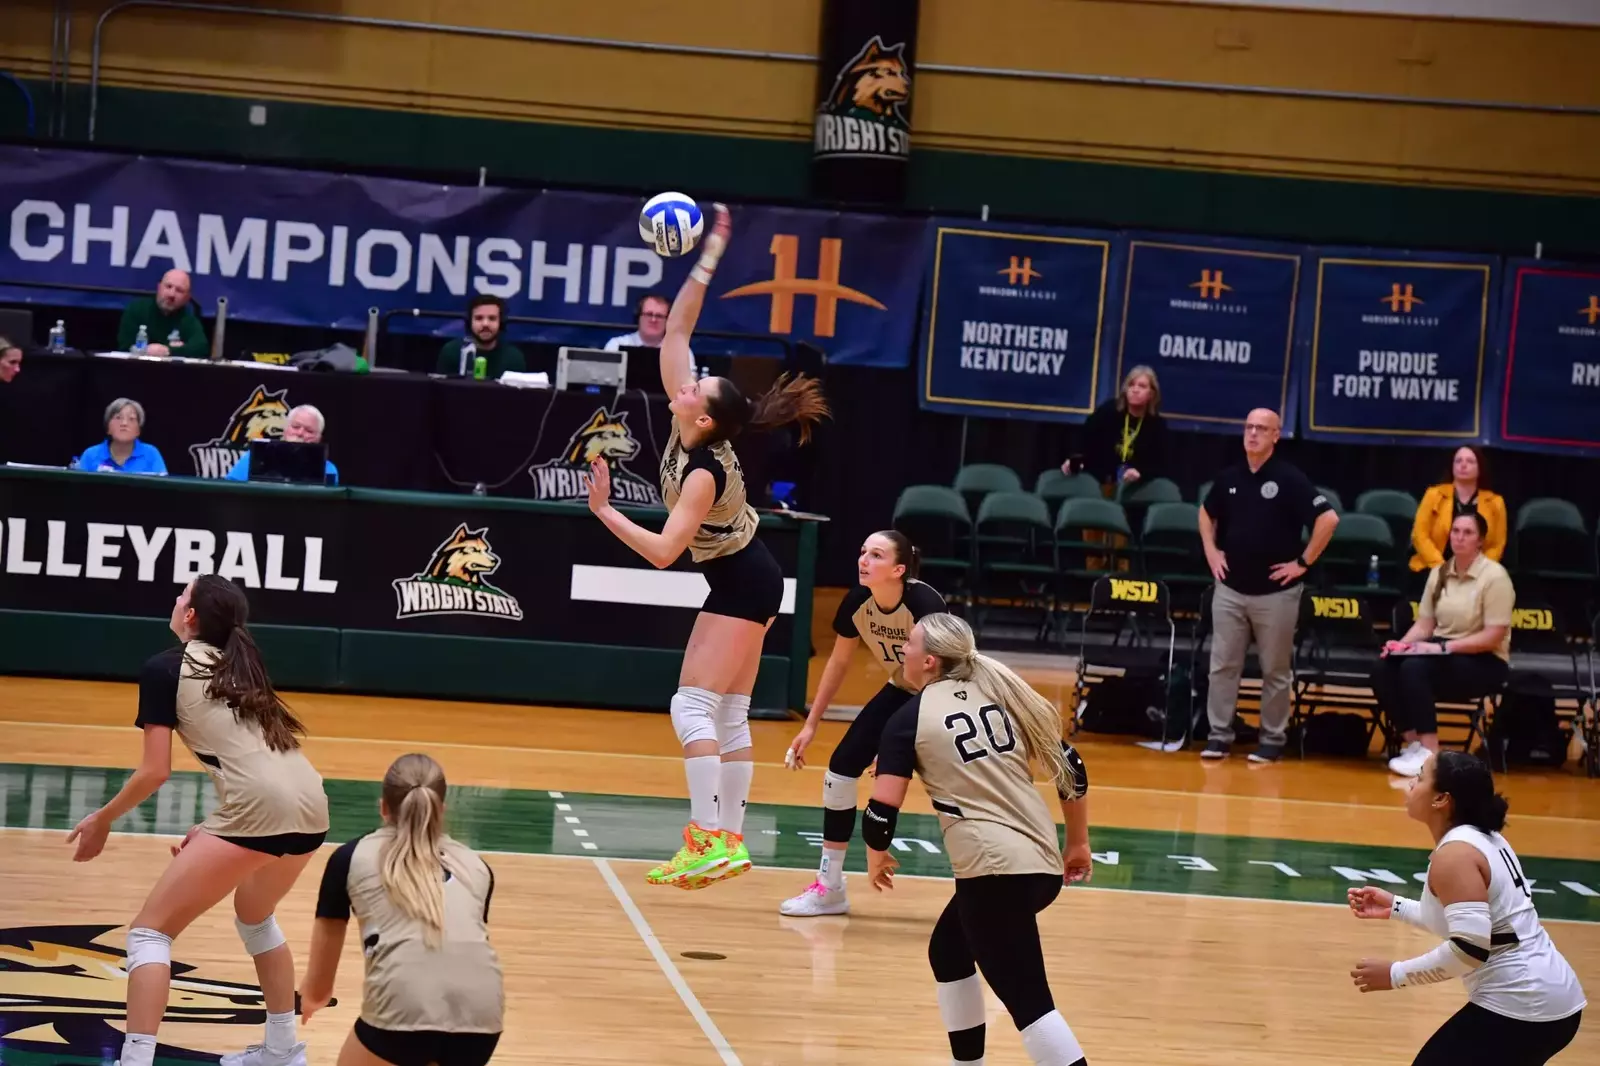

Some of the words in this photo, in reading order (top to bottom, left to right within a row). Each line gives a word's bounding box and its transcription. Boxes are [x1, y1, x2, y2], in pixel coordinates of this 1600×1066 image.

[10, 199, 664, 306] CHAMPIONSHIP
[962, 320, 1068, 351] NORTHERN
[1159, 333, 1252, 364] OAKLAND
[960, 346, 1065, 376] KENTUCKY
[1358, 350, 1439, 375] PURDUE
[1332, 374, 1384, 399] FORT
[1391, 376, 1460, 402] WAYNE
[612, 477, 658, 504] STATE
[0, 516, 339, 594] LLEYBALL
[399, 581, 474, 613] WRIGHT
[474, 590, 520, 617] STATE
[1109, 578, 1158, 603] WSU
[1311, 596, 1360, 619] WSU
[944, 703, 1017, 765] 20
